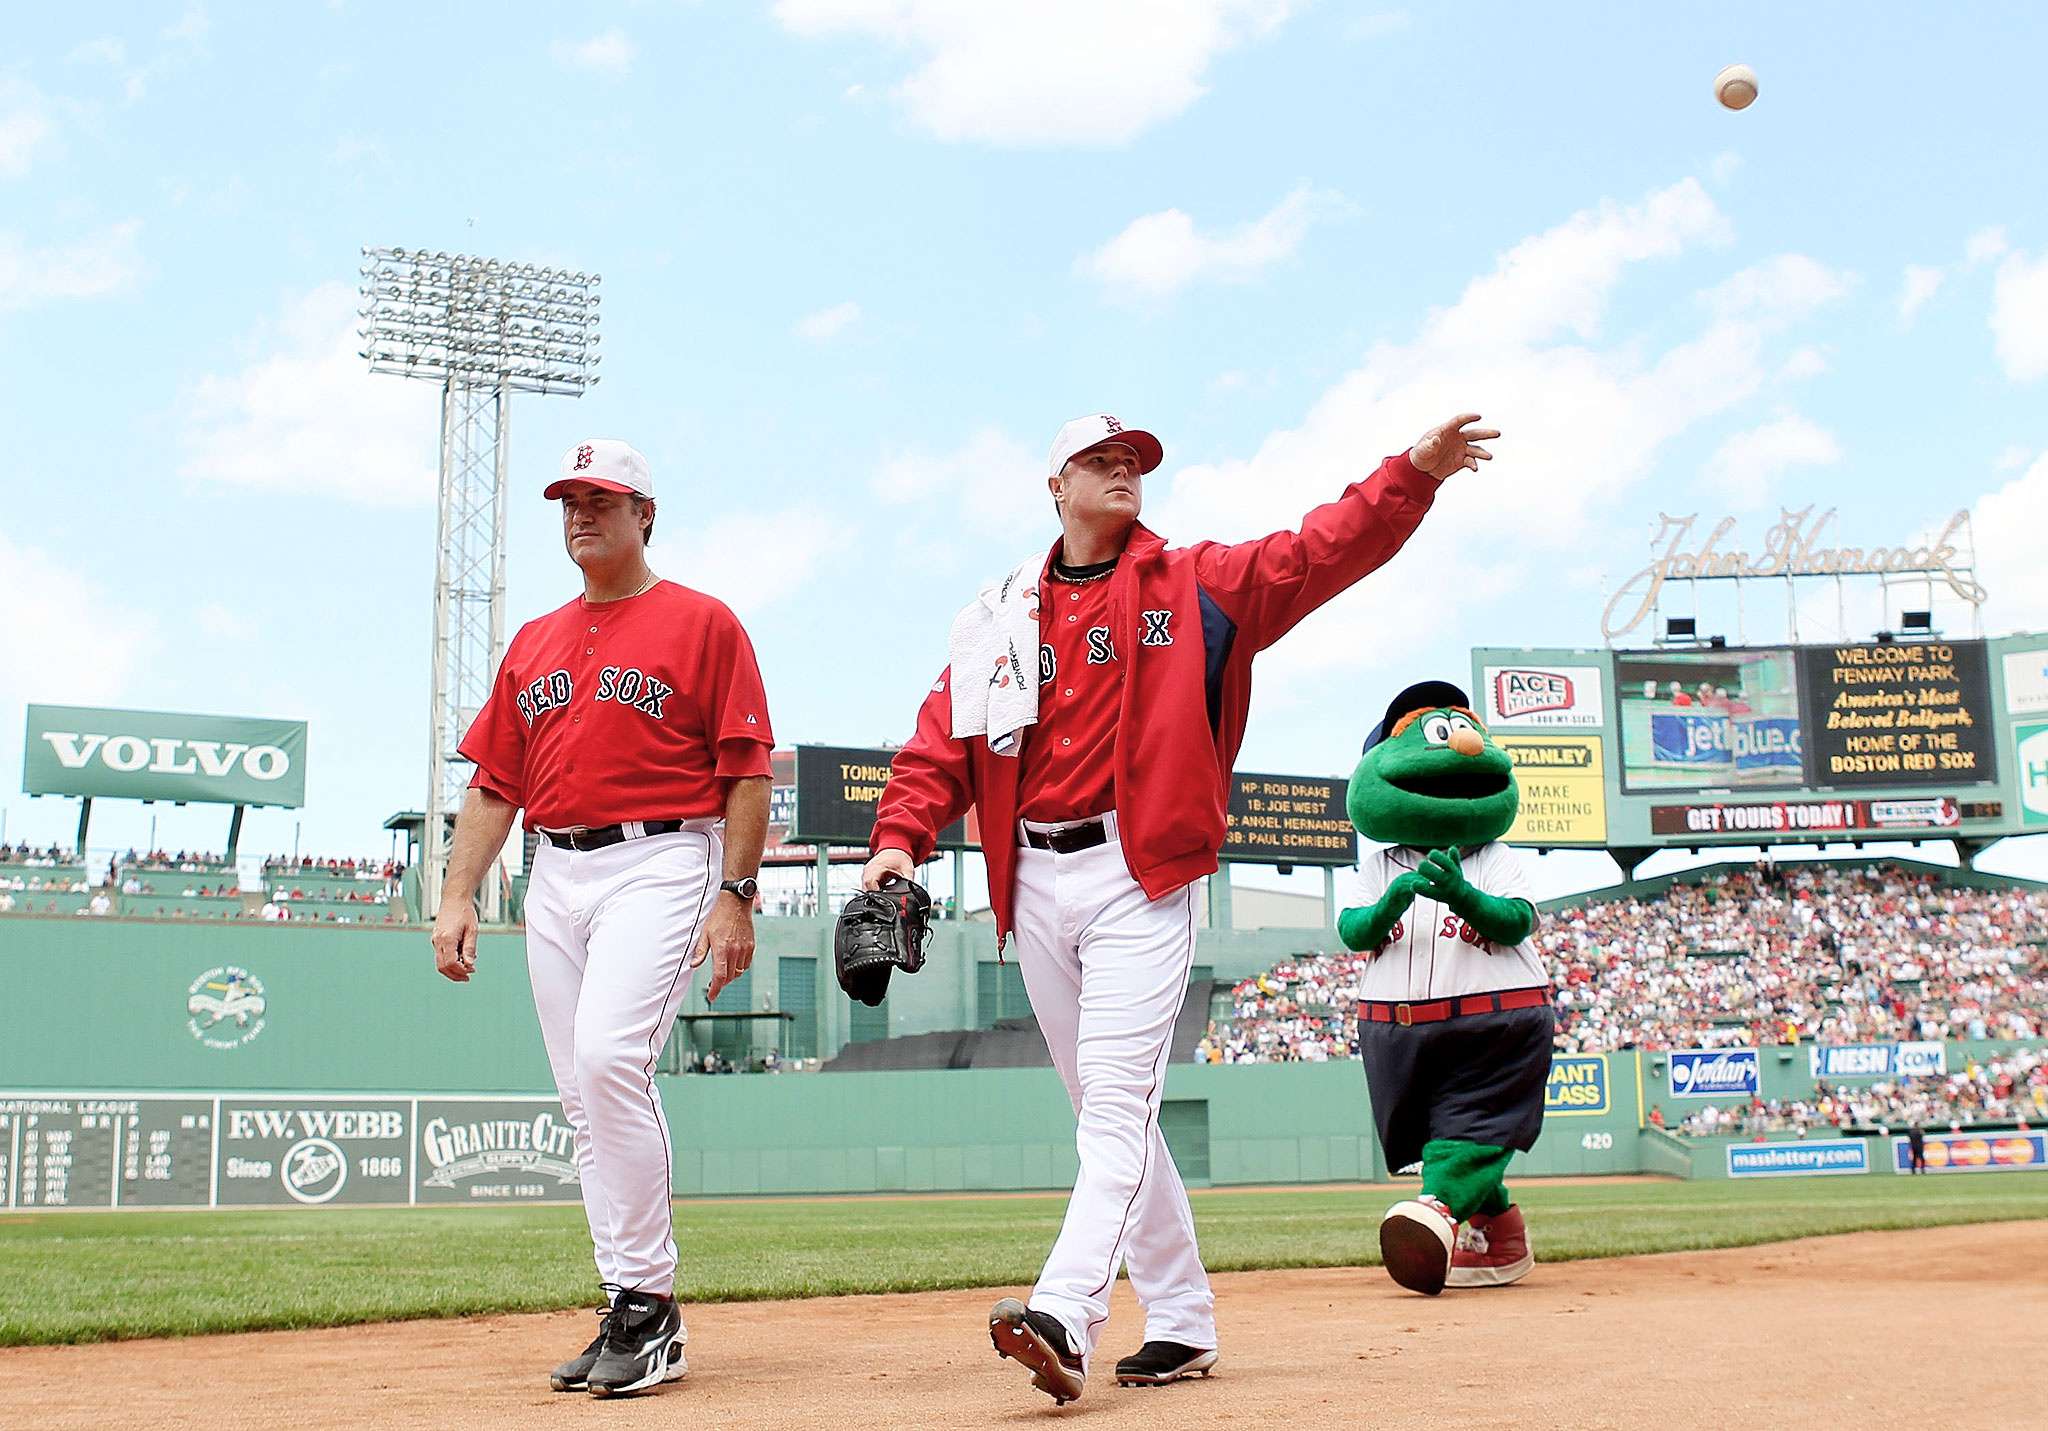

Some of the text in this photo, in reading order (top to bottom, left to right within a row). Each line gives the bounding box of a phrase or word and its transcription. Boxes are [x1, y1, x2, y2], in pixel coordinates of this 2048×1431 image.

[574, 445, 594, 471] B
[1602, 504, 1987, 638] John Hancock
[1087, 610, 1174, 665] SX
[1836, 645, 1953, 665] WELCOME TO
[1509, 674, 1564, 693] ACE
[1833, 667, 1904, 684] FENWAY
[517, 666, 674, 728] RED SOX
[1510, 695, 1565, 709] TICKET
[1834, 688, 1960, 709] America's Most
[1827, 710, 1895, 729] Beloved
[1846, 732, 1958, 753] HOME OF THE
[42, 731, 290, 780] VOLVO
[1507, 748, 1588, 764] STANLEY
[1830, 751, 1976, 773] BOSTON RED SOX
[840, 764, 893, 782] TONIGH
[844, 785, 885, 802] UMPI
[1241, 782, 1331, 799] HP: ROB DRAKE
[1528, 785, 1570, 798] MAKE
[1247, 799, 1327, 814] 1B: JOE WEST
[1517, 803, 1592, 815] OMETHING
[1226, 814, 1353, 832] B: ANGEL HERNANDEZ
[1527, 820, 1571, 832] GREAT
[1687, 807, 1722, 831] GET
[1722, 806, 1785, 830] YOURS
[1226, 831, 1348, 849] 3B: PAUL SCHRIEBER
[1827, 1048, 1889, 1073] NESN
[1548, 1064, 1599, 1084] ANT
[1682, 1053, 1757, 1093] Jordan's
[1545, 1085, 1600, 1106] LASS
[78, 1101, 138, 1114] LEAGUE
[27, 1115, 38, 1128] P
[128, 1115, 140, 1128] P
[228, 1110, 403, 1139] F.W. WEBB
[1581, 1133, 1613, 1150] 420
[486, 1153, 536, 1164] SUPPLY
[1733, 1148, 1862, 1167] masslottery.com
[226, 1157, 272, 1178] Since
[359, 1157, 402, 1178] 1866
[470, 1184, 545, 1198] SINCE 1923
